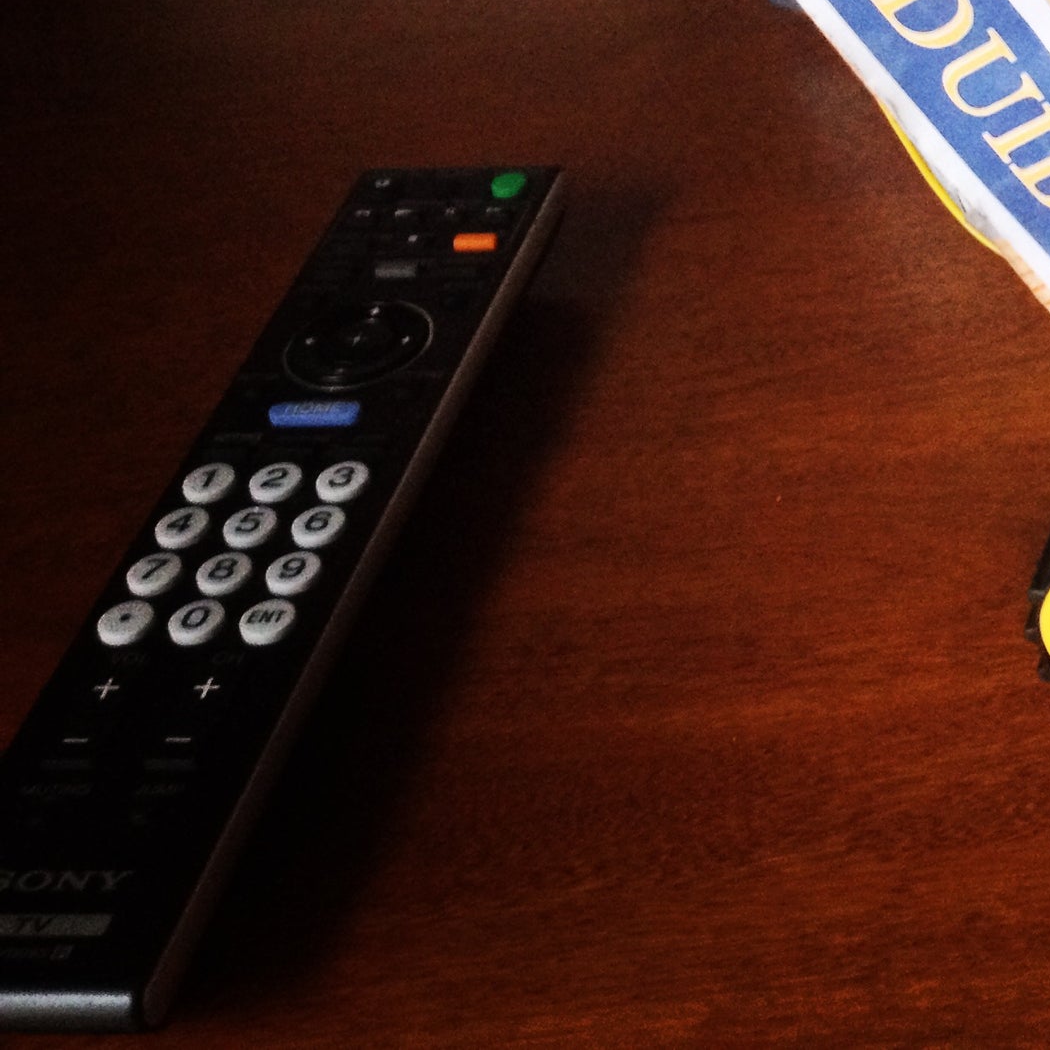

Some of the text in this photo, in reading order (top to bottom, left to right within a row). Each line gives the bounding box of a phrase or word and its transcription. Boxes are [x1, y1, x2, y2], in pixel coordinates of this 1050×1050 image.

[199, 465, 356, 489] 1 2 3
[167, 510, 333, 535] 4 5 6
[141, 557, 307, 581] 7 8 9
[181, 605, 286, 630] 0 ENT
